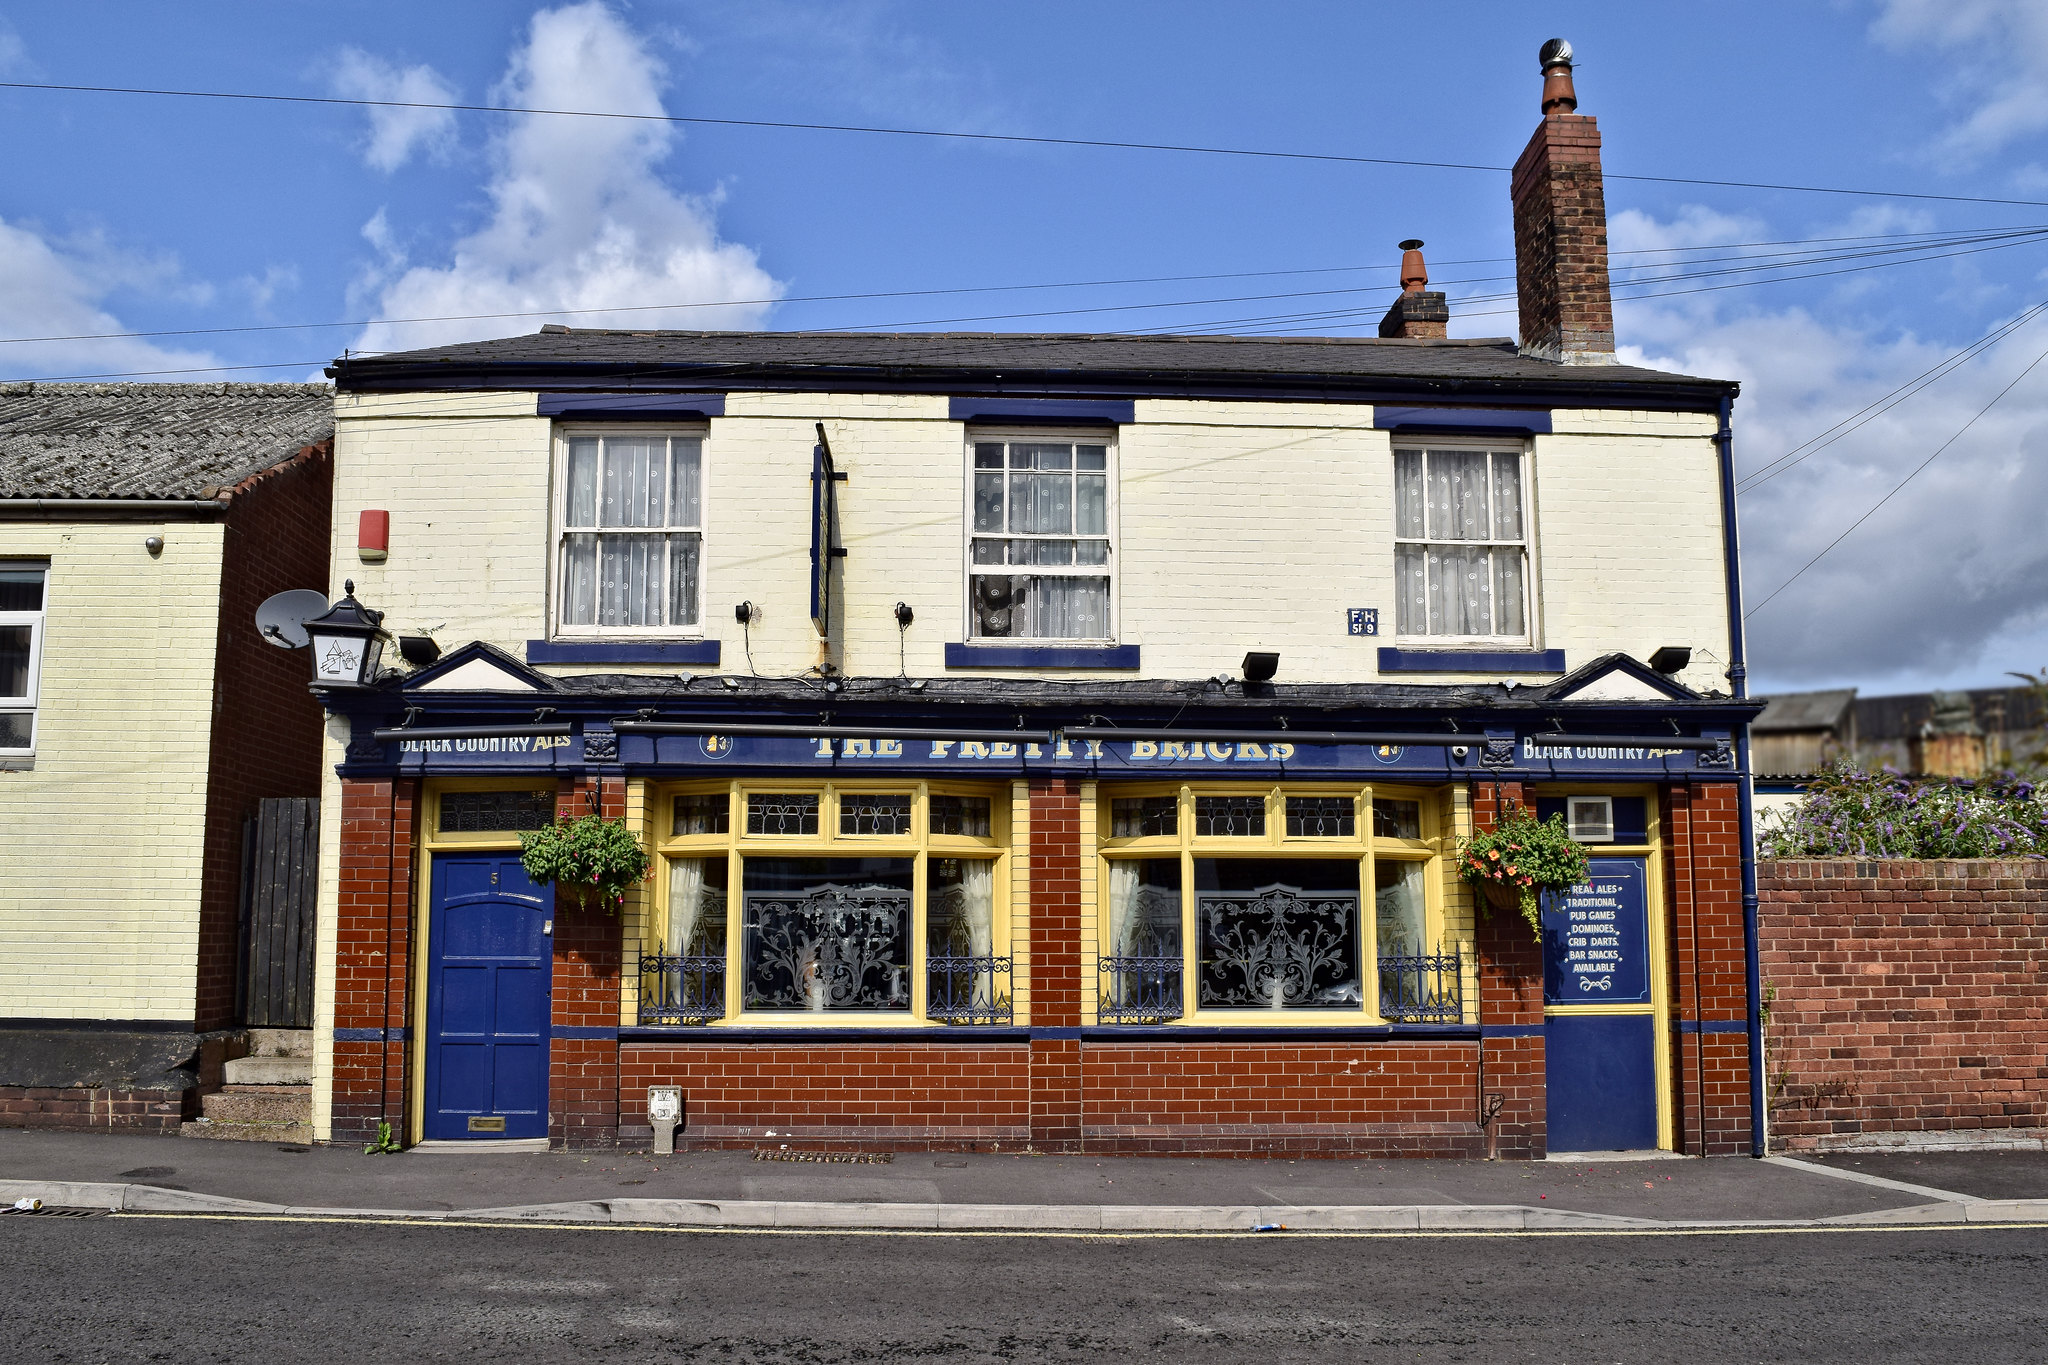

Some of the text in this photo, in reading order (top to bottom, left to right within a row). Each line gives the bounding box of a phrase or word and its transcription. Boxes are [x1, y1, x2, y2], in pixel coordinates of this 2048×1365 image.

[810, 738, 902, 758] THE
[1130, 741, 1294, 762] BRICKS
[490, 872, 498, 885] 5
[1572, 885, 1617, 894] REAL ALES
[1566, 898, 1617, 908] TRADITIONAL
[1570, 911, 1616, 920] PUB GAMES
[1568, 937, 1587, 947] CRIB
[1569, 950, 1619, 960] BAR SNACKS
[1572, 963, 1616, 973] AVAILABLE
